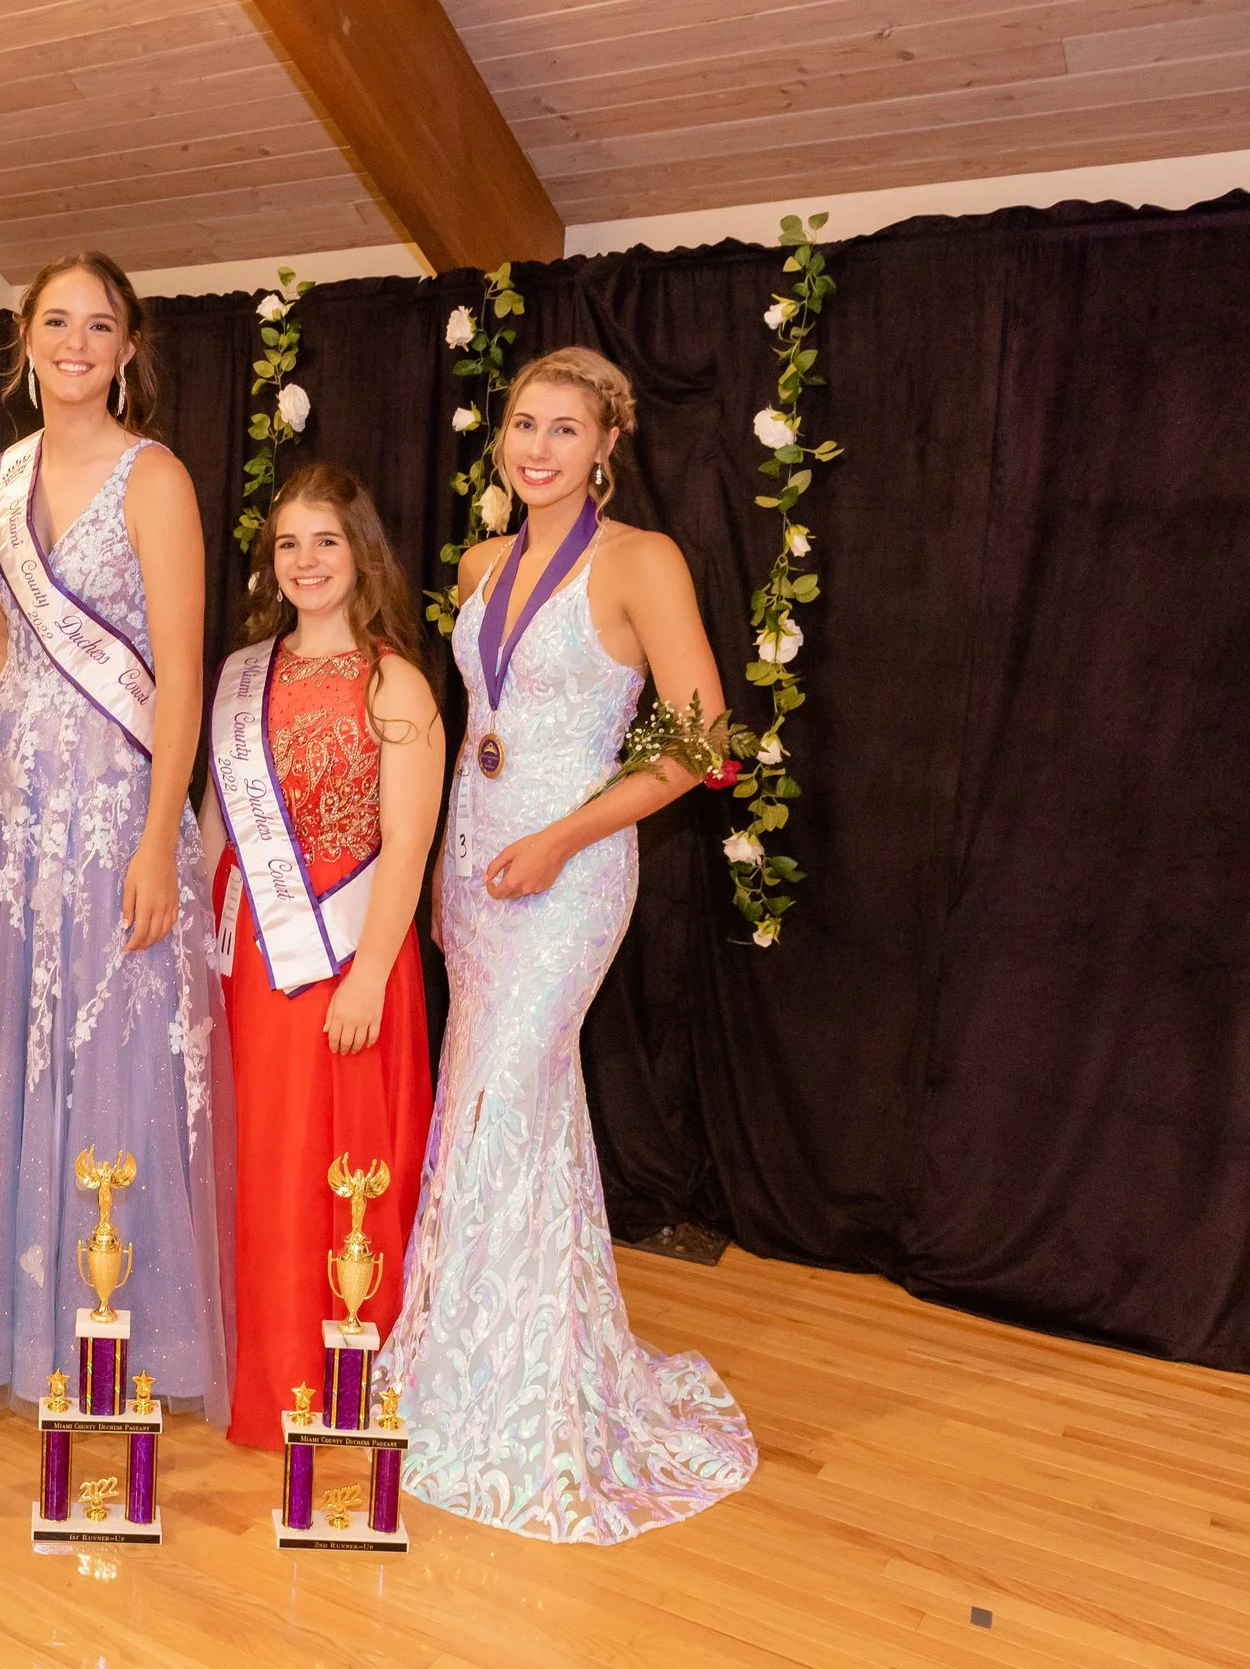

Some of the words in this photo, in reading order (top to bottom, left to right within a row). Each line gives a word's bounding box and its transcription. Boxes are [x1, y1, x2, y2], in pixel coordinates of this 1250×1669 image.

[9, 500, 24, 549] Miami
[21, 559, 49, 608] County
[54, 615, 110, 665] Duchess
[118, 668, 150, 706] Court
[27, 611, 54, 640] 2022
[237, 657, 261, 700] Miami
[230, 711, 255, 761] County
[217, 758, 238, 792] 2022
[244, 779, 273, 841] Duchess
[459, 833, 468, 858] 3
[267, 858, 294, 900] Court
[78, 1476, 120, 1503] 2022
